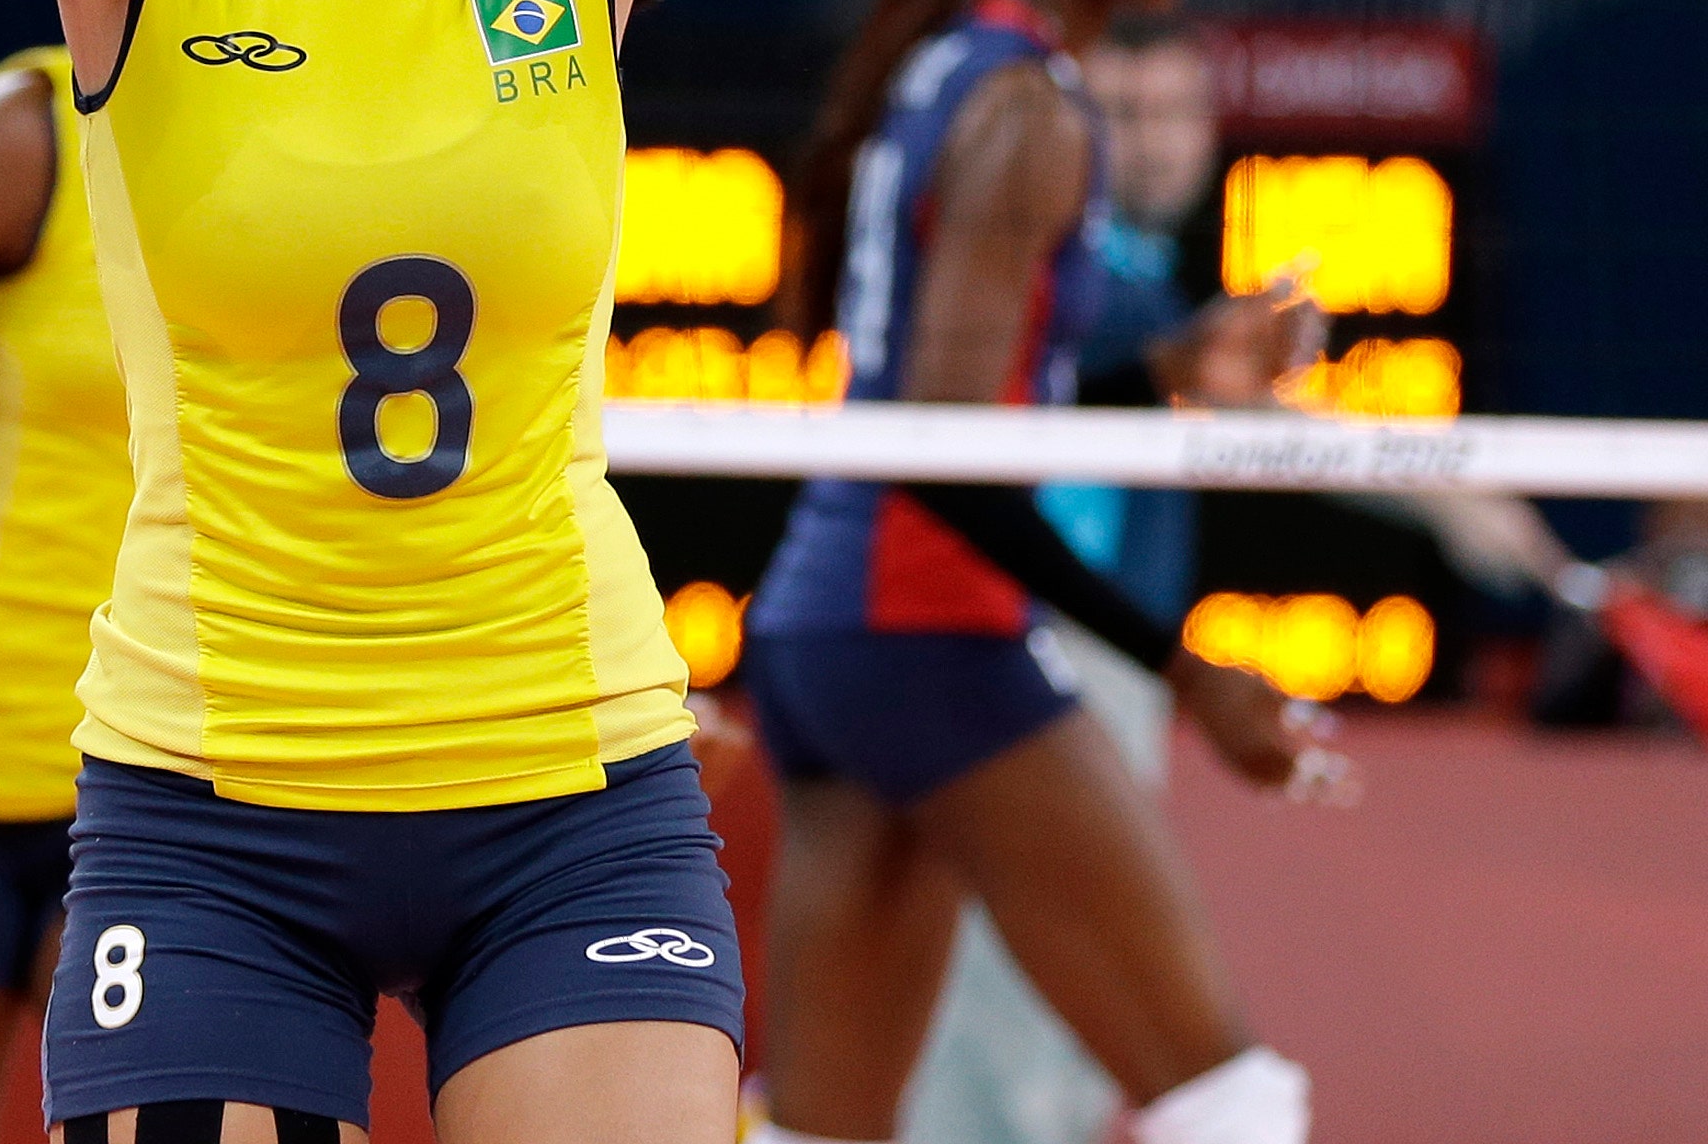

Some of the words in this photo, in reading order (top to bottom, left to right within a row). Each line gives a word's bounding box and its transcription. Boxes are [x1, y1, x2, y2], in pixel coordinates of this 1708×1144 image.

[493, 55, 587, 103] BRA
[335, 254, 477, 500] 8
[90, 923, 146, 1028] 8
